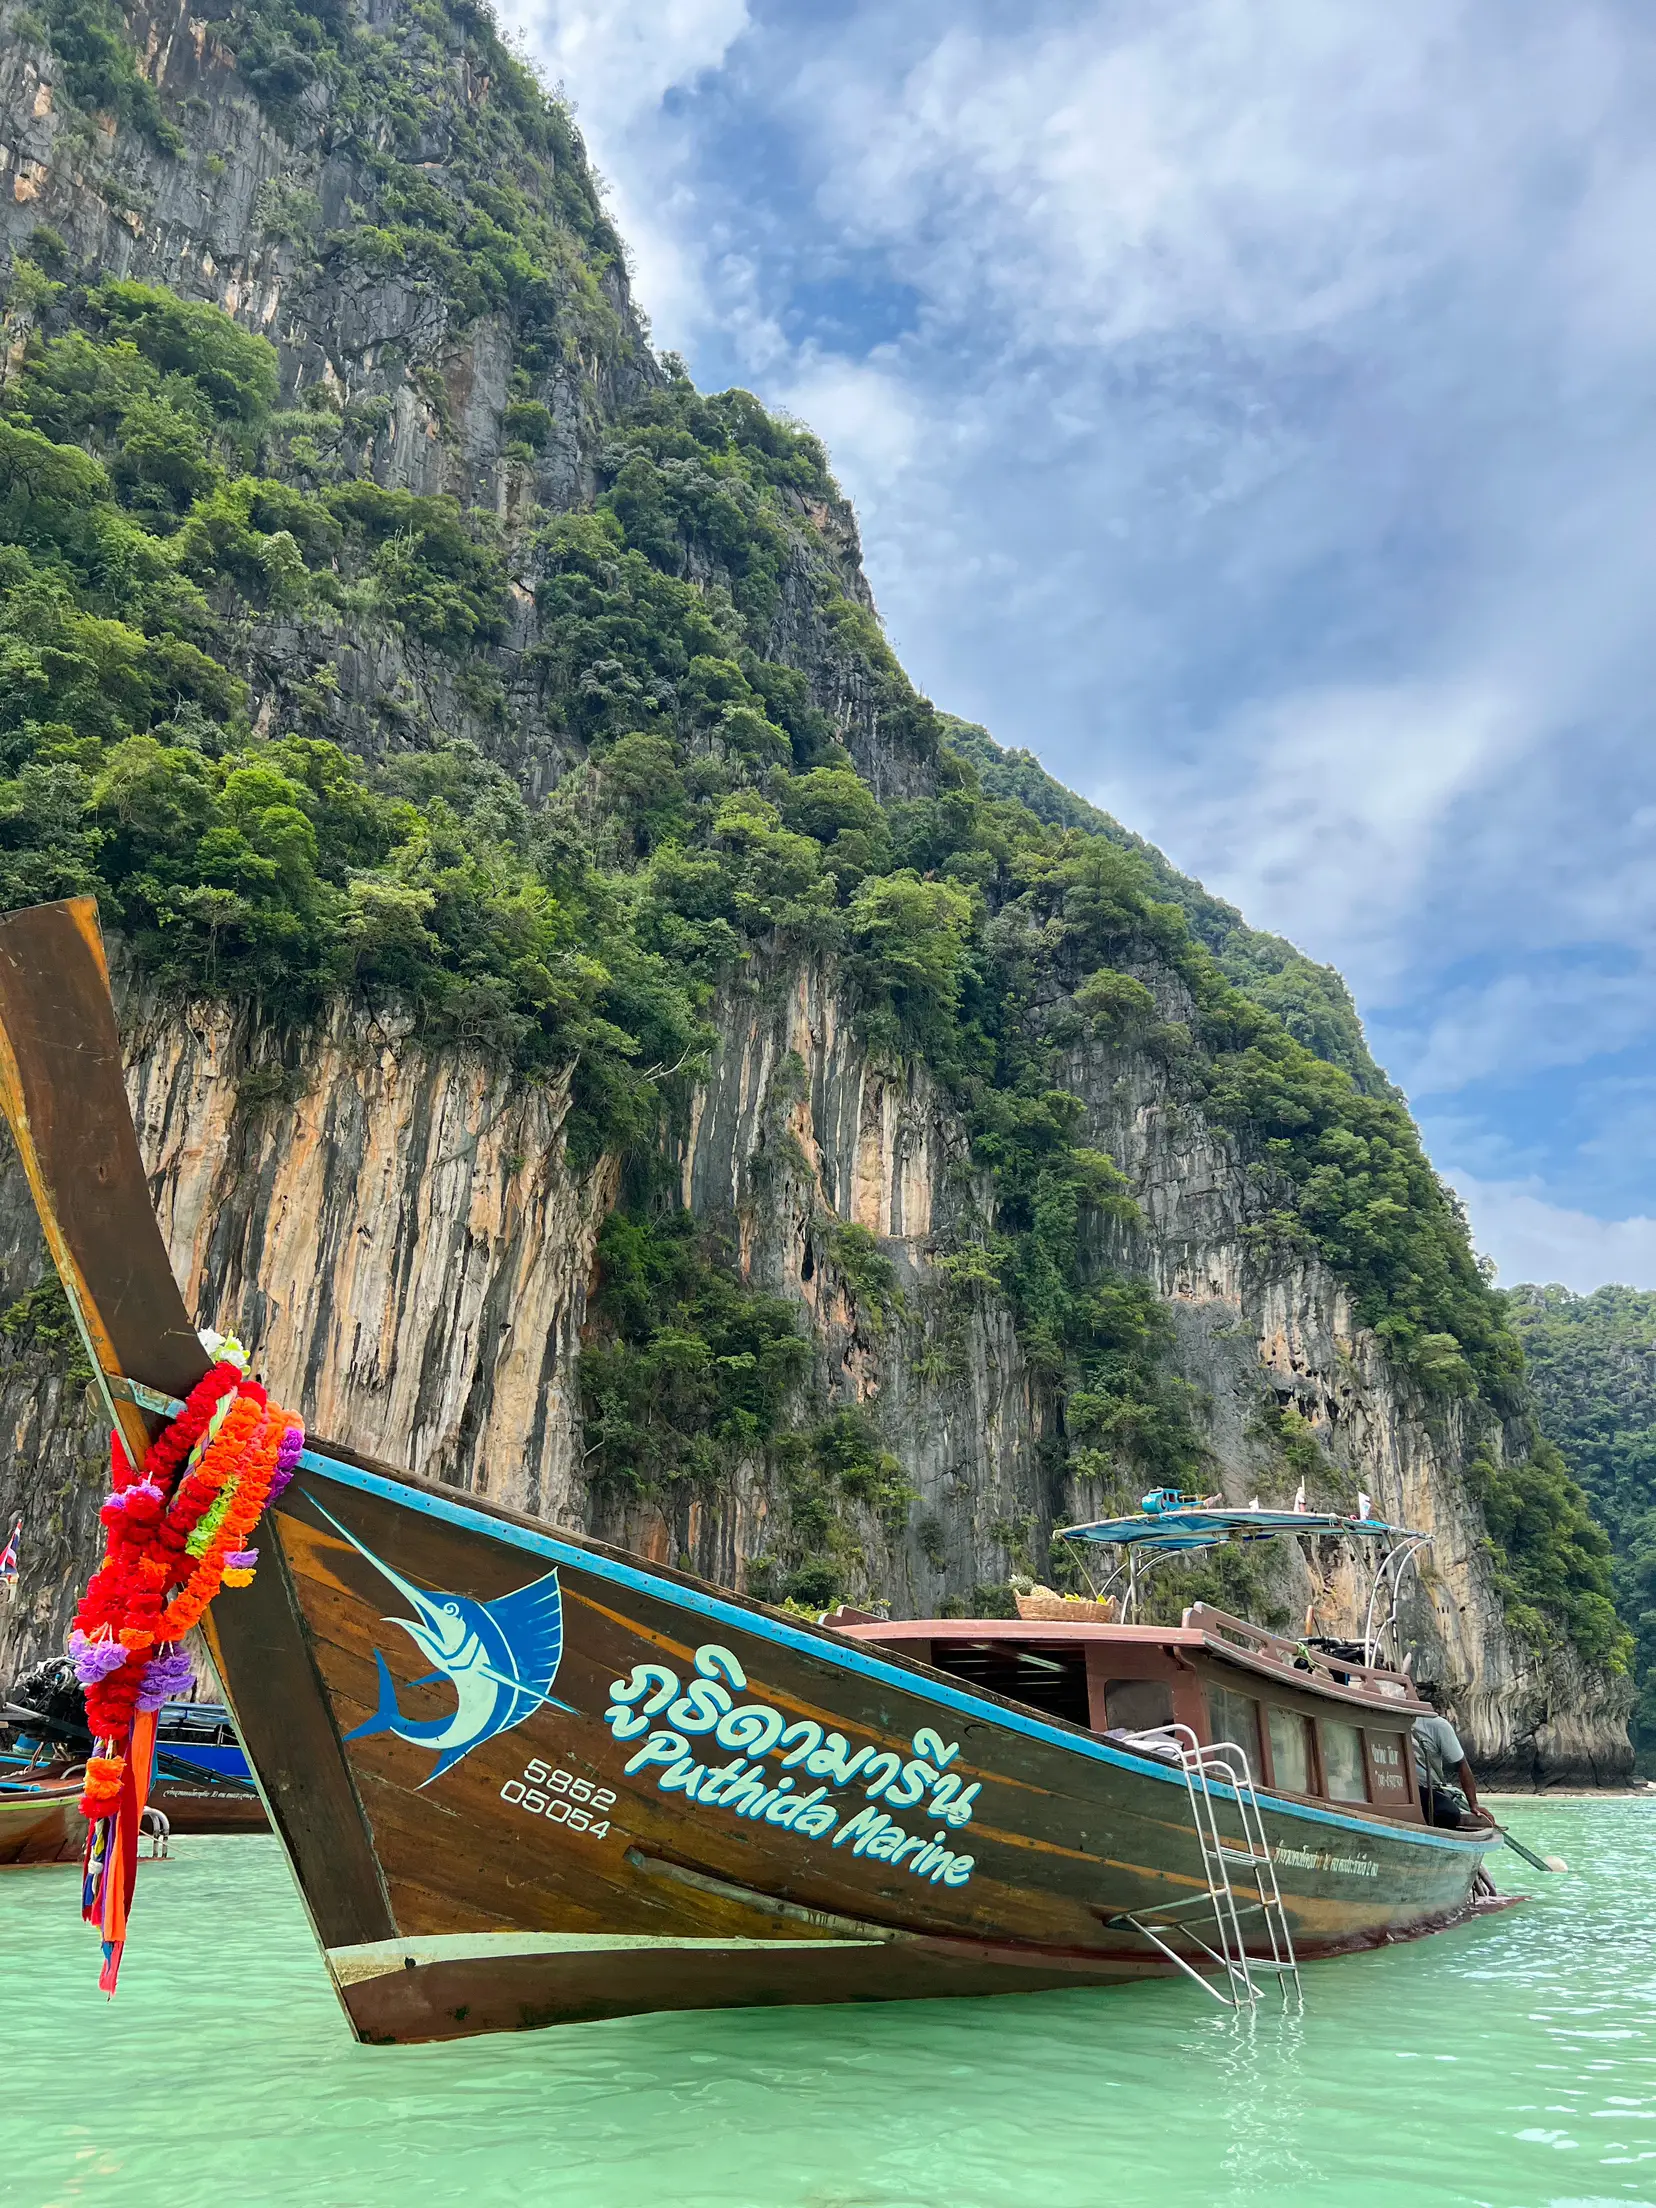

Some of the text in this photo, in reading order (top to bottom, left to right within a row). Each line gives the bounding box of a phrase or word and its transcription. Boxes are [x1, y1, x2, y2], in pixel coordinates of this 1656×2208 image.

[500, 1779, 611, 1840] 05054
[523, 1757, 617, 1812] 5852
[624, 1731, 975, 1887] Puthida Marine
